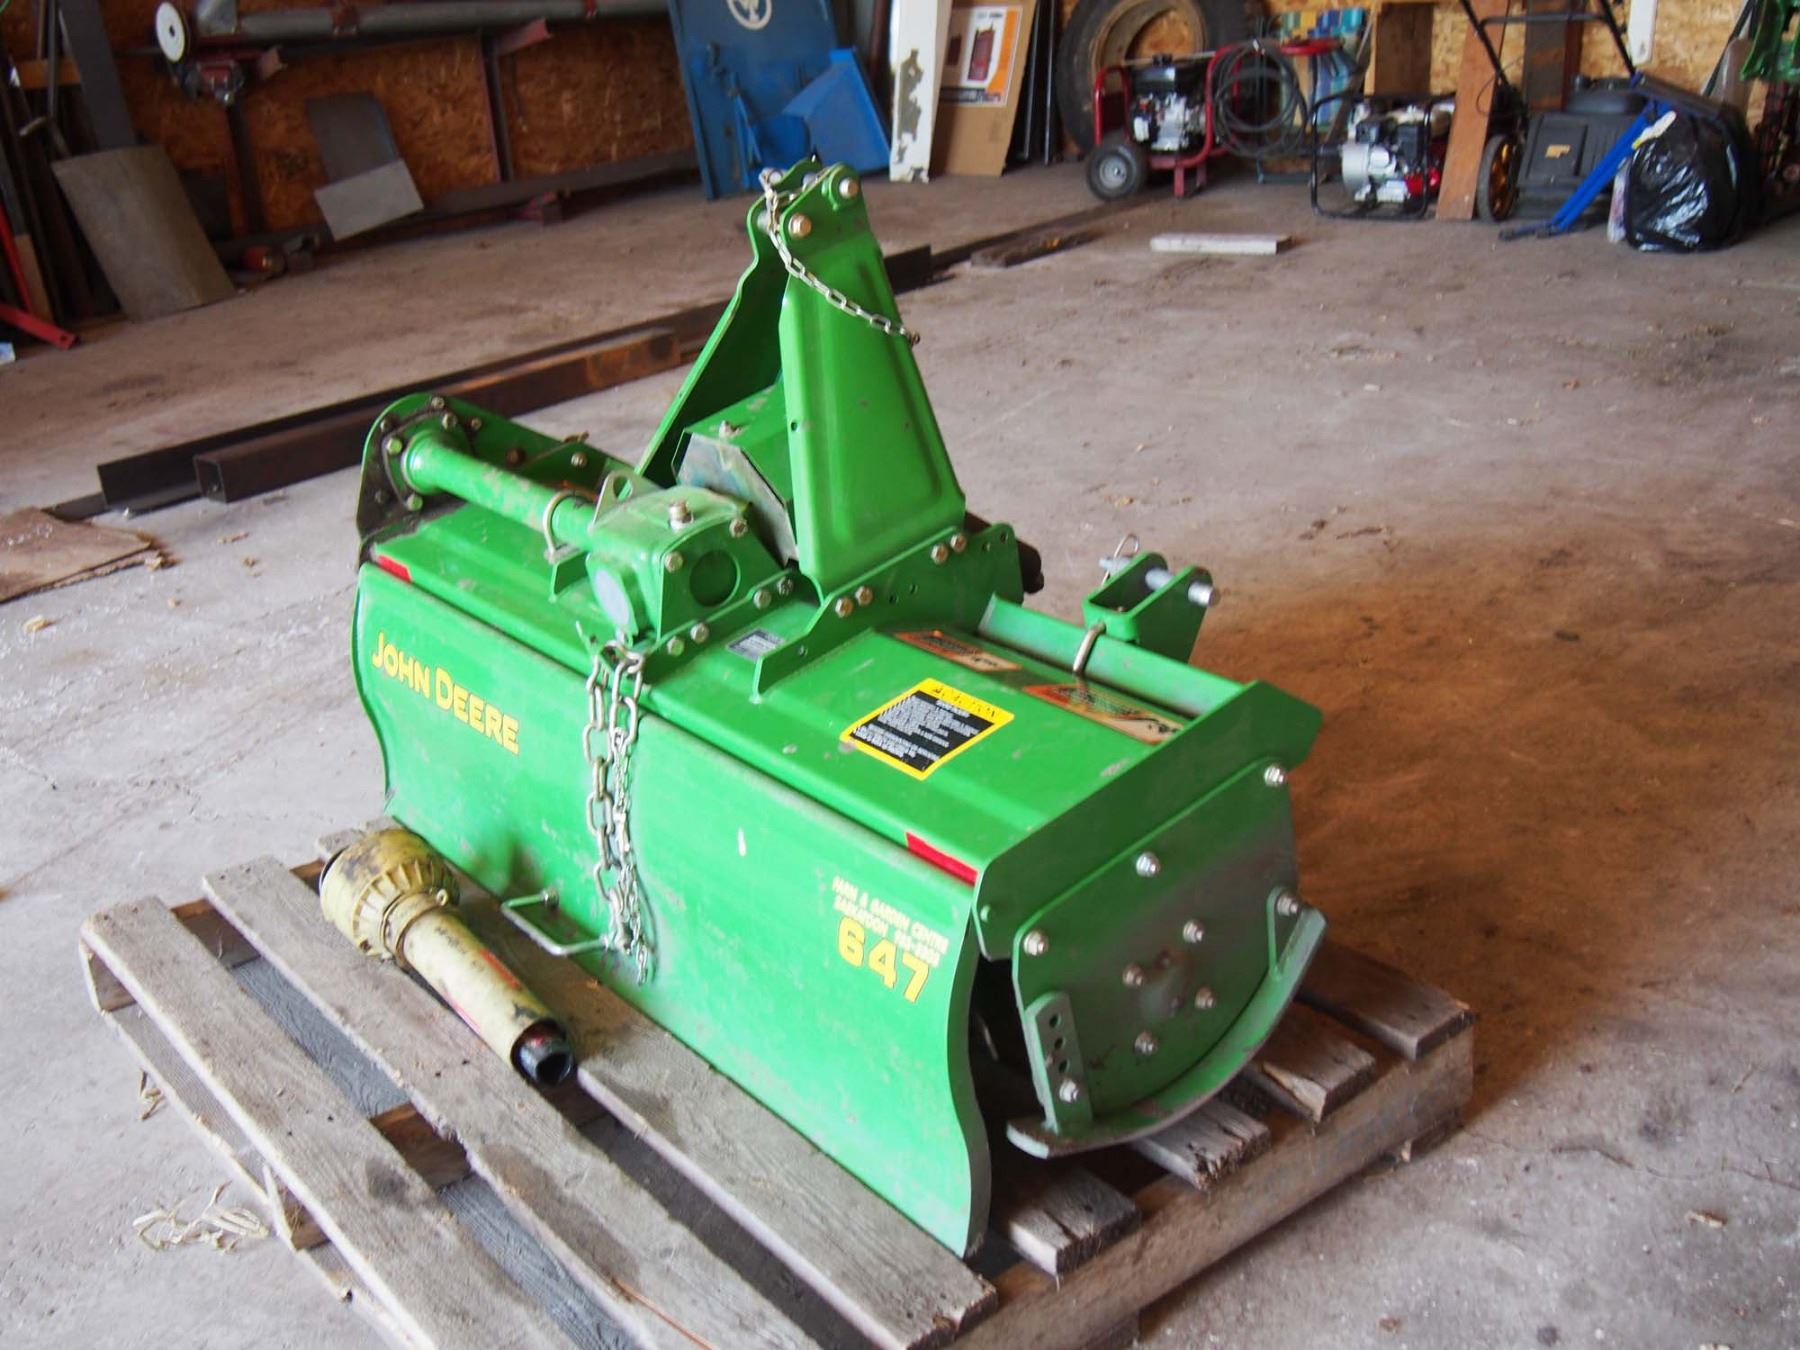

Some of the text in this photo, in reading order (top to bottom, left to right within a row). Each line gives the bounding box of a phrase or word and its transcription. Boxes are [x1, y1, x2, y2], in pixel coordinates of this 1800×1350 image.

[372, 631, 520, 756] JOHN DEERE
[838, 915, 929, 1004] 647
